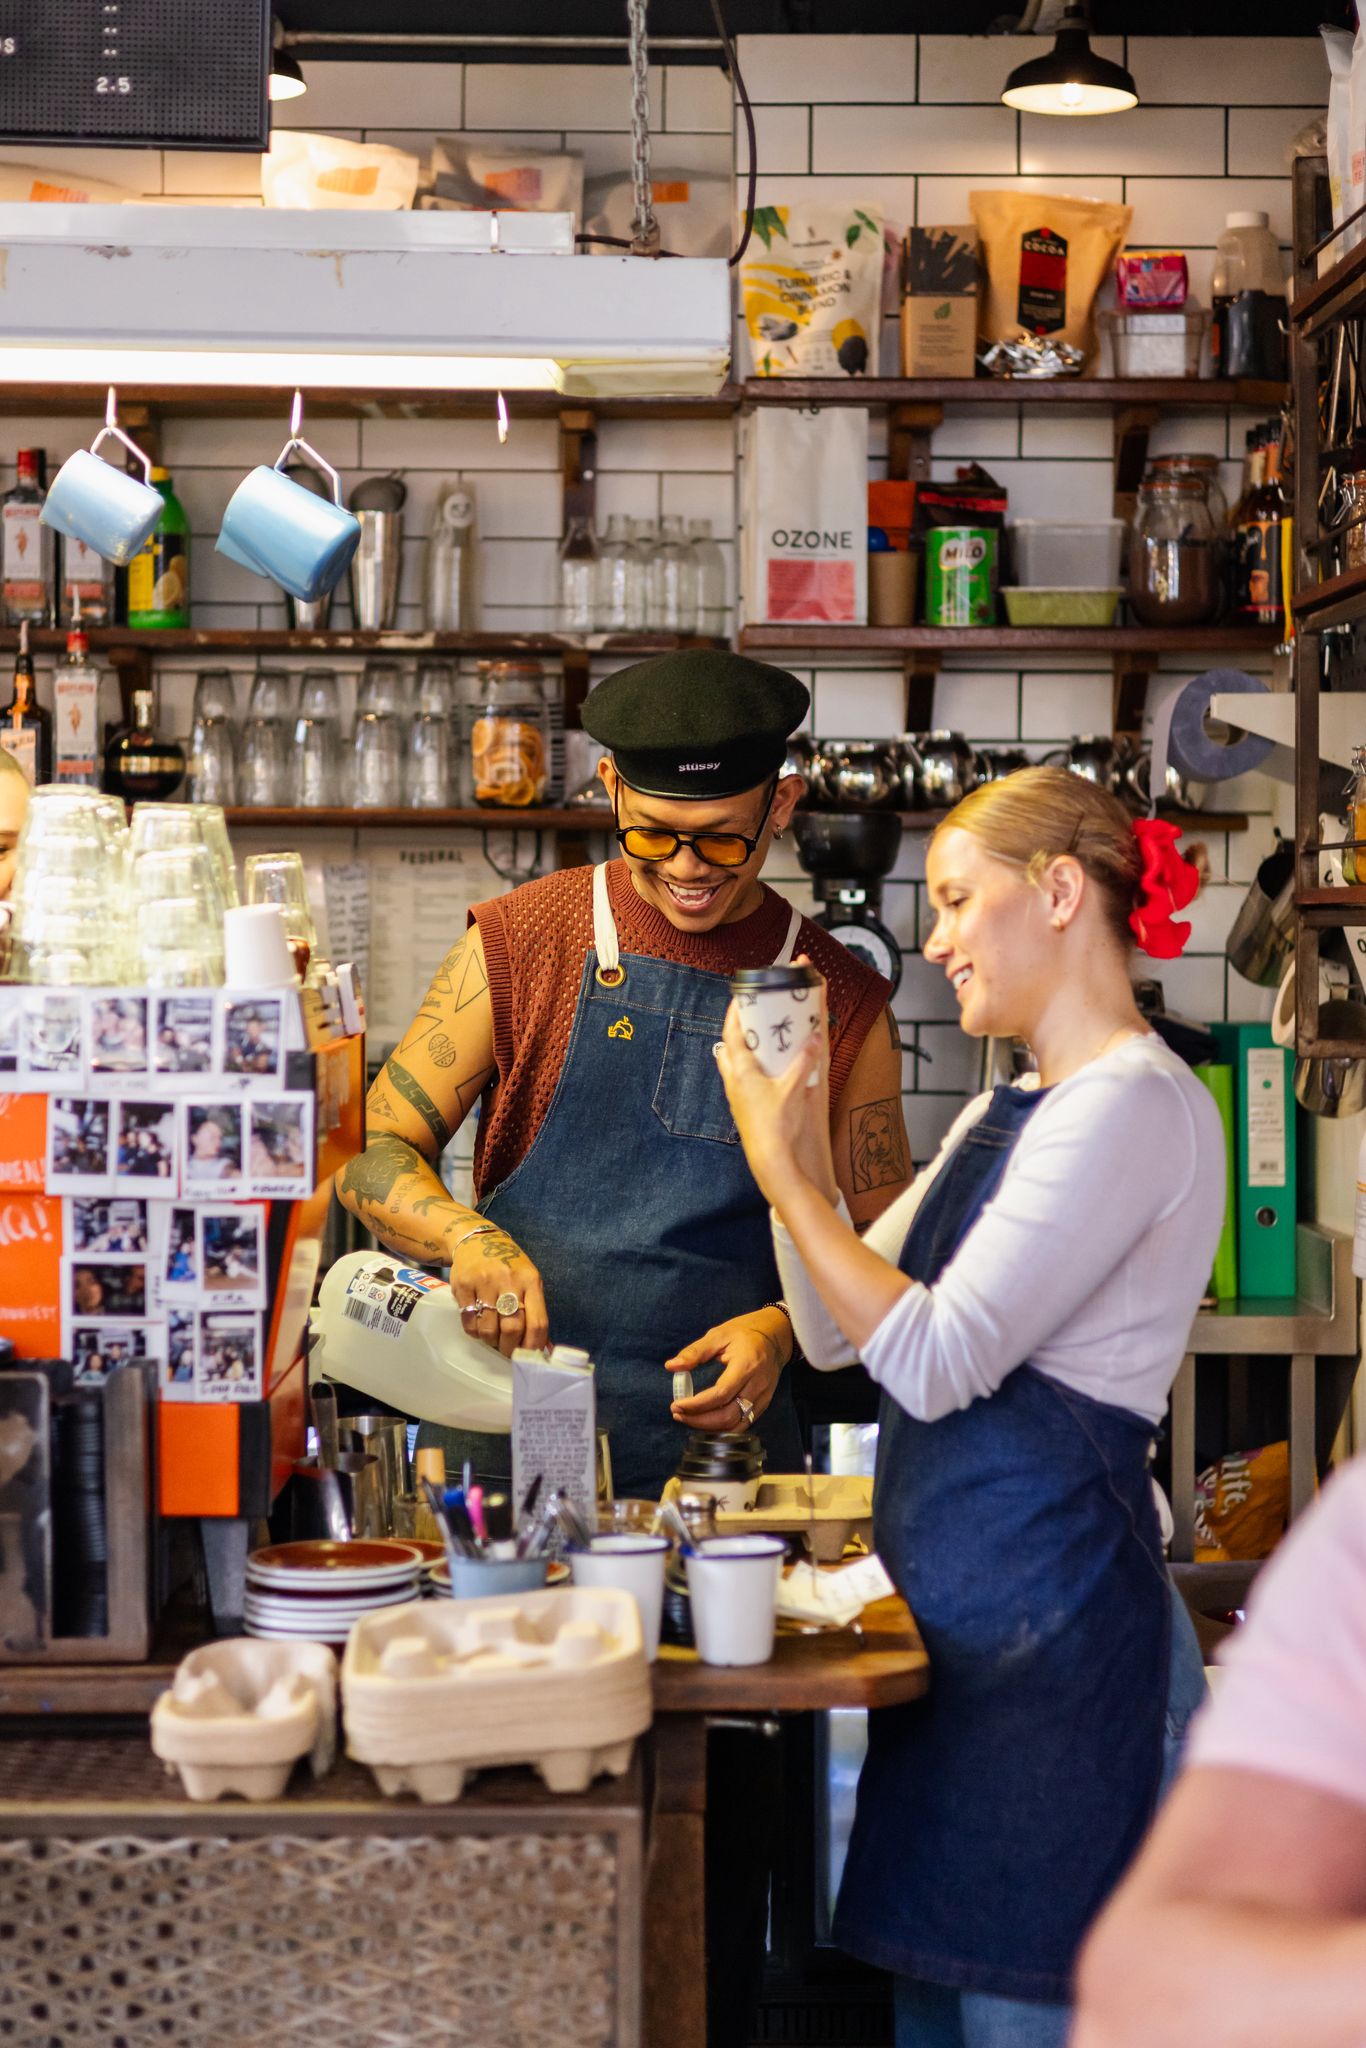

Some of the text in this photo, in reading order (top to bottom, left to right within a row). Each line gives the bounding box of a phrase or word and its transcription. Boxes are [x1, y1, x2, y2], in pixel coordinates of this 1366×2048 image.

[96, 76, 131, 93] 2.5
[1023, 241, 1065, 256] COCOA
[772, 530, 853, 549] OZONE
